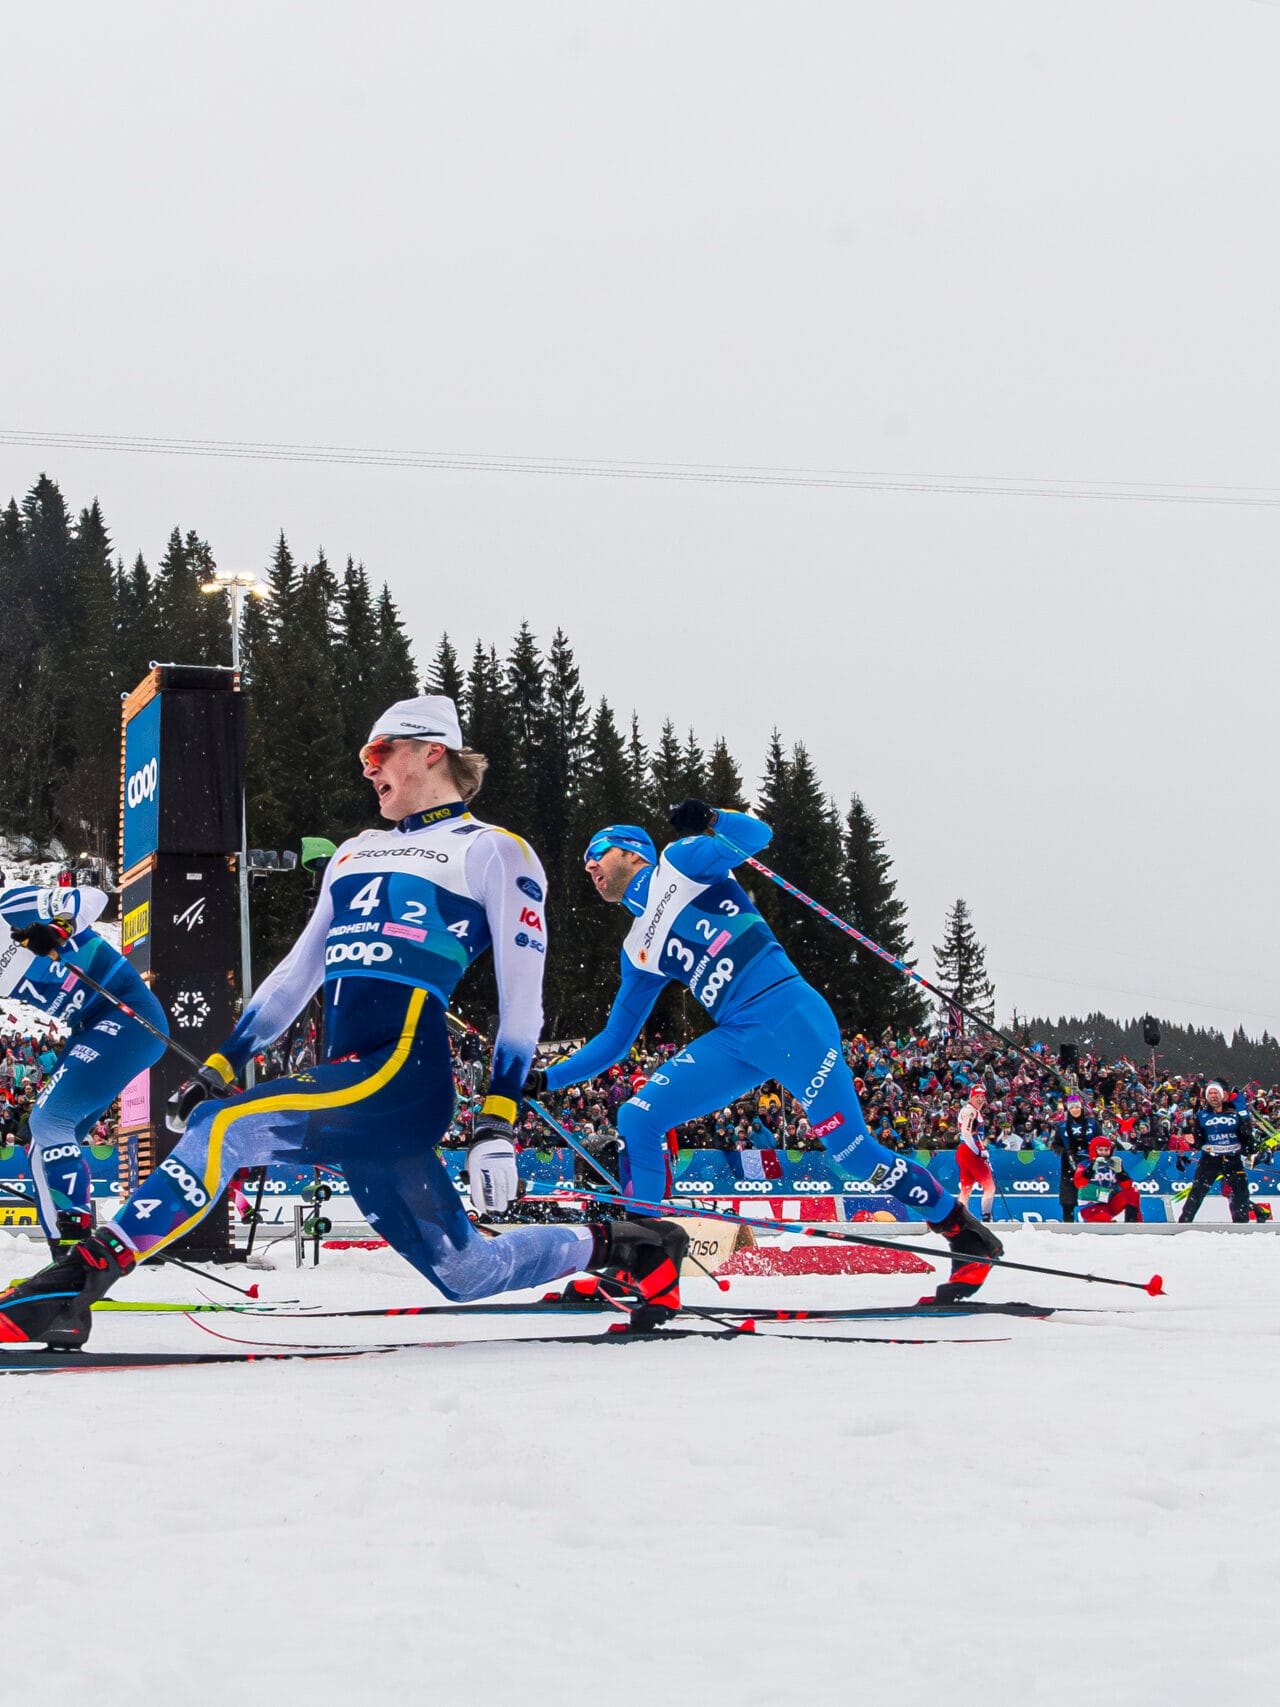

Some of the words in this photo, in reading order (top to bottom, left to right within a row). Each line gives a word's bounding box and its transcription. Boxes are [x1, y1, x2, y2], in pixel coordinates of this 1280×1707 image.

[128, 757, 157, 808] coop
[354, 847, 449, 863] StoraEnso
[349, 876, 383, 916] 4
[401, 901, 427, 924] 2
[719, 899, 740, 917] 3
[447, 920, 469, 937] 4
[696, 919, 718, 939] 2
[667, 938, 694, 971] 3
[49, 961, 68, 978] 2
[19, 980, 47, 1003] 7
[62, 1172, 77, 1195] 7
[160, 1158, 207, 1208] coop
[675, 1181, 714, 1192] coop
[734, 1181, 772, 1192] coop
[793, 1181, 831, 1192] coop
[1013, 1181, 1050, 1193] coop
[909, 1186, 928, 1204] 3
[133, 1199, 162, 1219] 4
